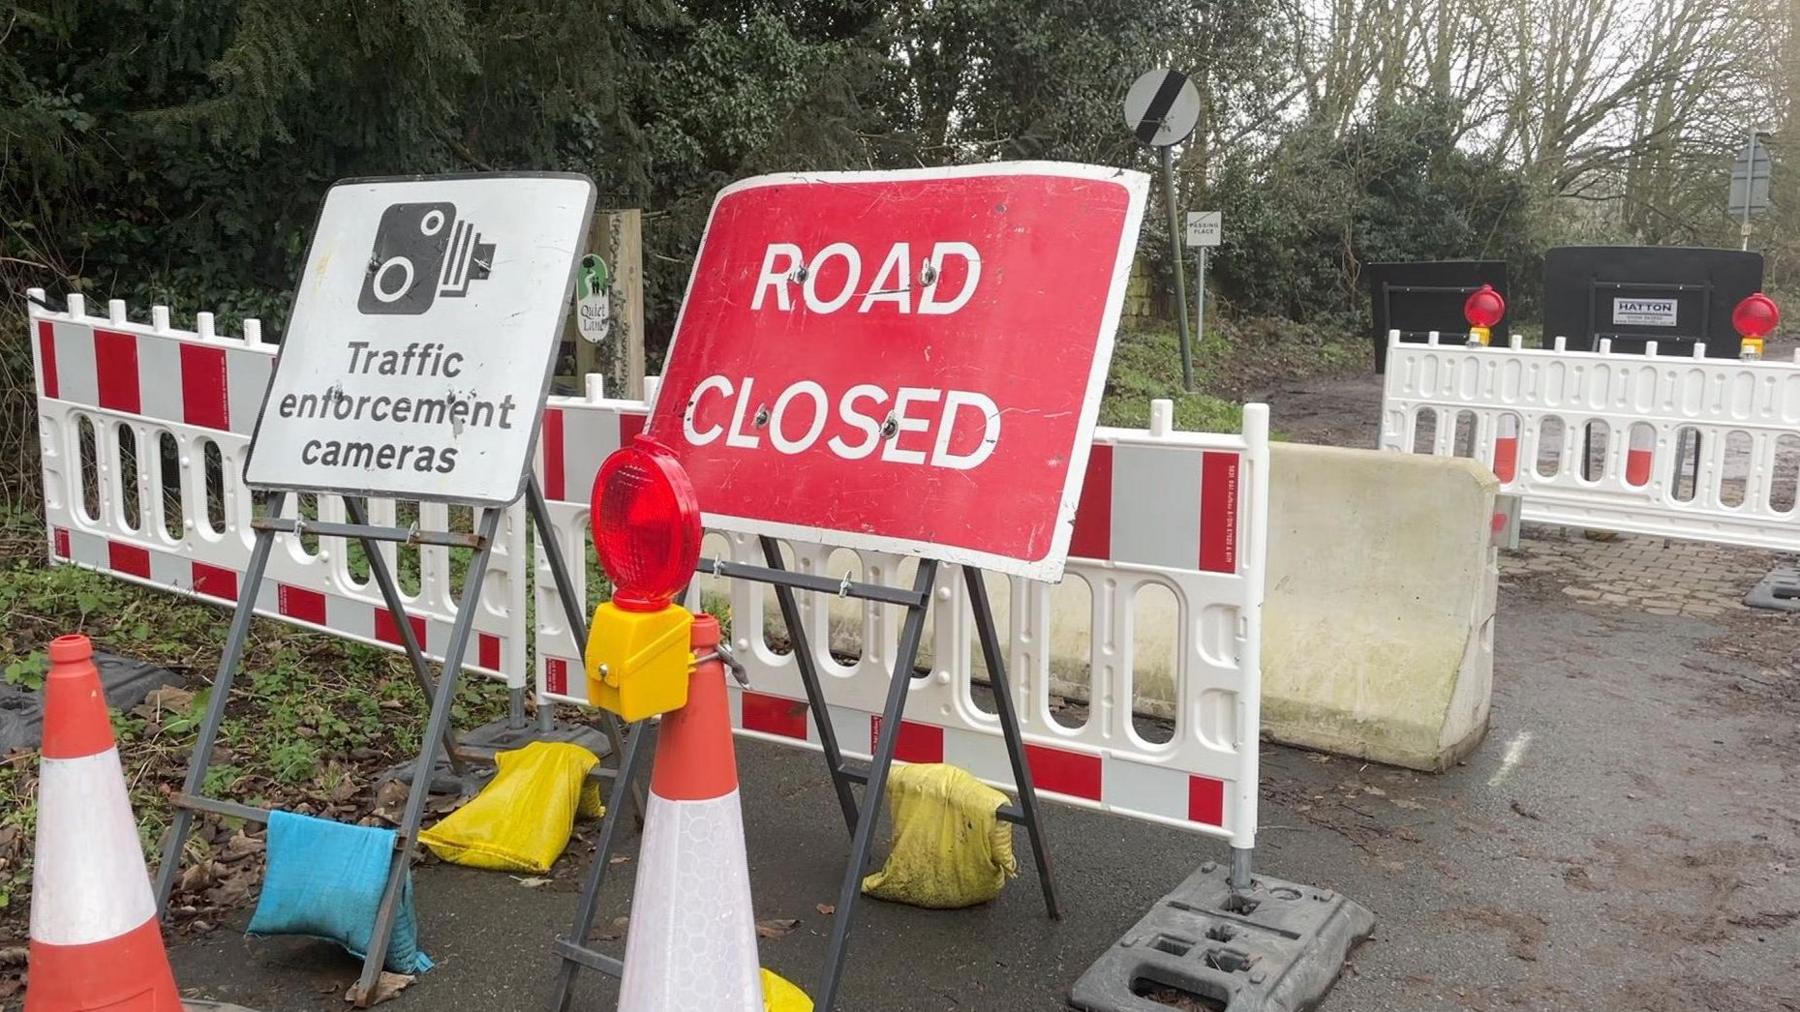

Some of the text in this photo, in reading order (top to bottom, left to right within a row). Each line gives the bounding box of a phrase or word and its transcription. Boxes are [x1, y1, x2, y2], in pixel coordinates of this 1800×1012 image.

[750, 241, 982, 315] ROAD
[581, 303, 605, 319] Quiet
[1619, 303, 1672, 312] HATTON
[347, 341, 464, 378] Traffic
[279, 384, 517, 430] enforcement
[682, 374, 1001, 471] CLOSED
[301, 439, 459, 474] cameras
